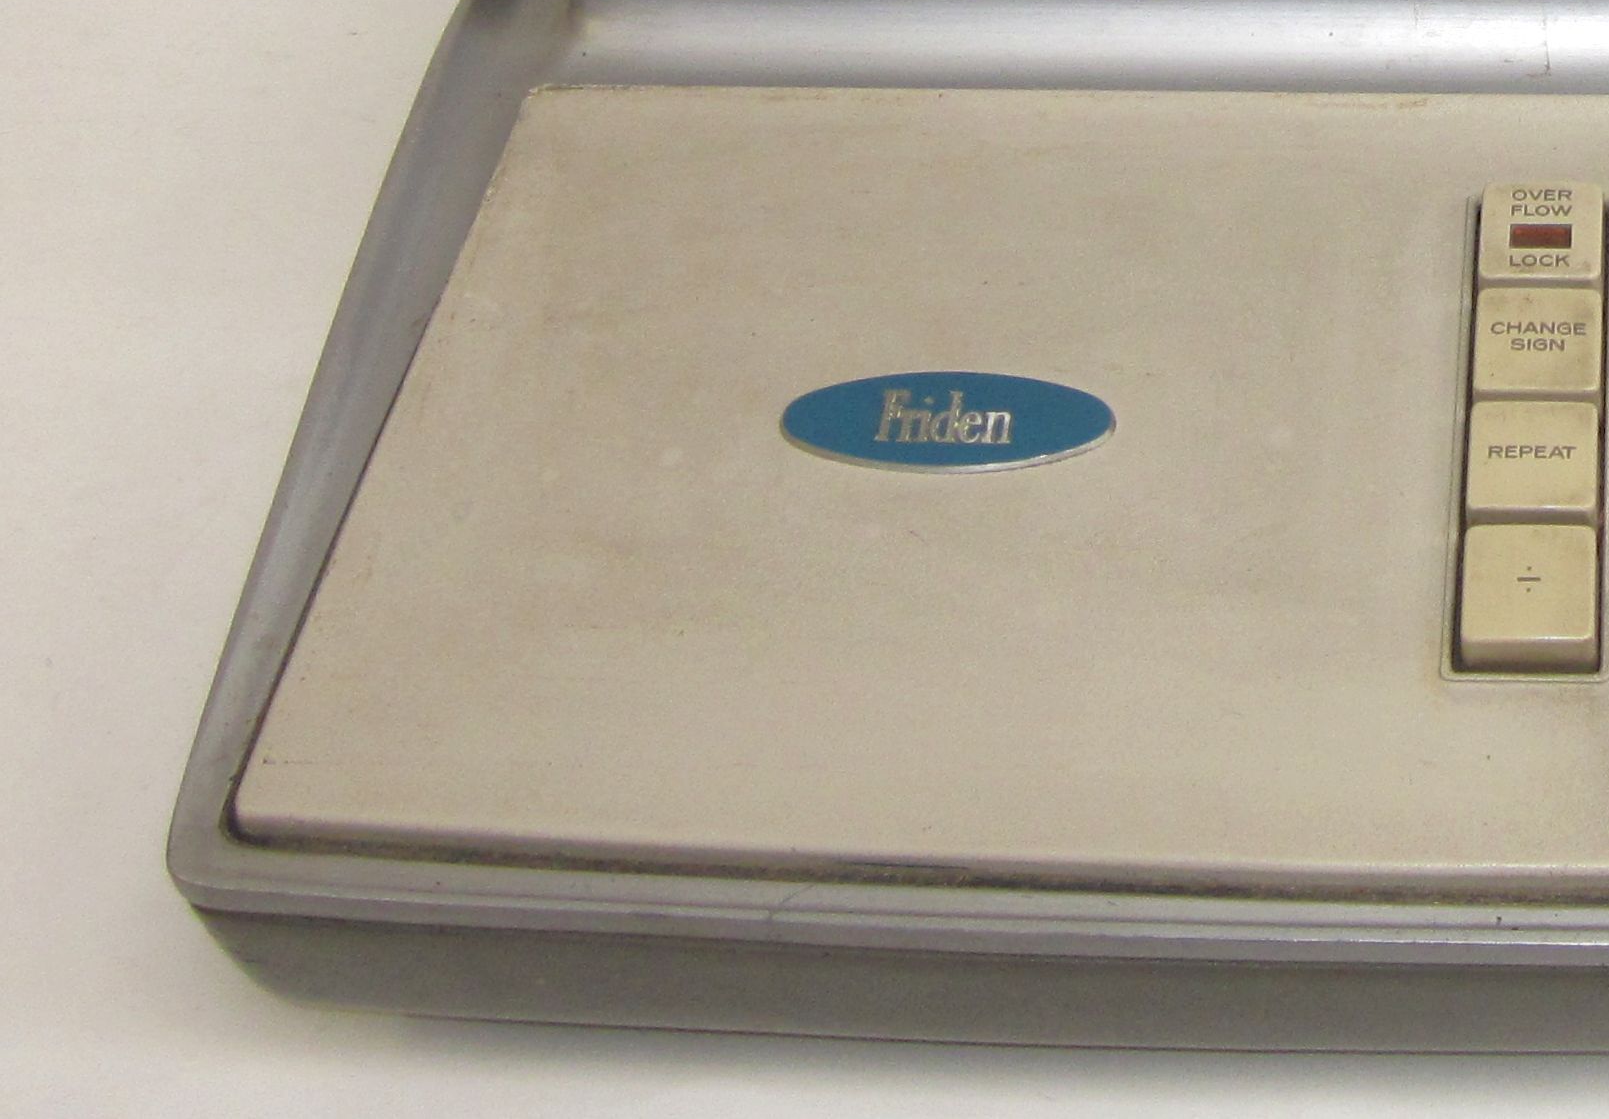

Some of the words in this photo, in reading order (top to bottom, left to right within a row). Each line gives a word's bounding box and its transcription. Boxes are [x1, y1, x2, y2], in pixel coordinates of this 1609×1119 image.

[1512, 188, 1573, 202] OVER
[1511, 204, 1573, 217] FLOW
[1509, 254, 1570, 268] LOCK
[1490, 321, 1587, 336] CHANGE
[1511, 338, 1565, 352] SIGN
[874, 389, 1012, 444] Friden
[1487, 444, 1576, 459] REPEAT
